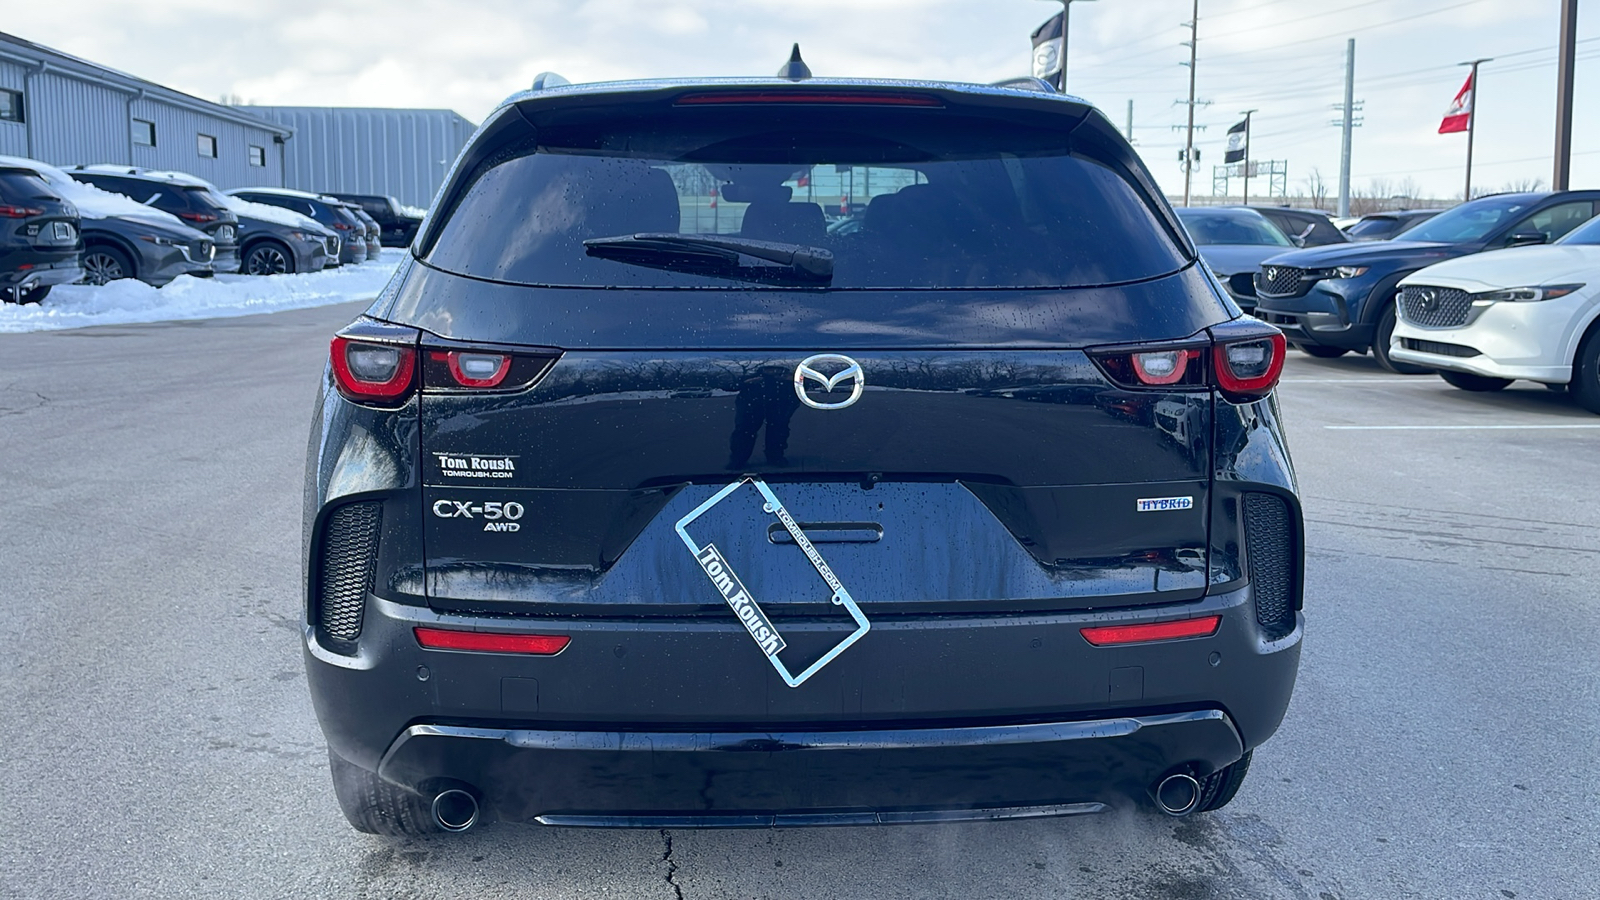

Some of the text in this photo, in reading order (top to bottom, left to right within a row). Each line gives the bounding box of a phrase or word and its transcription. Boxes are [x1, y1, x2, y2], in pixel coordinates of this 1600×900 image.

[438, 456, 516, 471] Tom Roush
[442, 470, 513, 478] TOMROUSH.COM
[432, 500, 525, 520] CX-50
[1141, 498, 1191, 510] HYBRID
[483, 522, 520, 532] AWD
[778, 507, 841, 592] TOMROUSH.COM
[700, 547, 779, 656] Tom Roush
